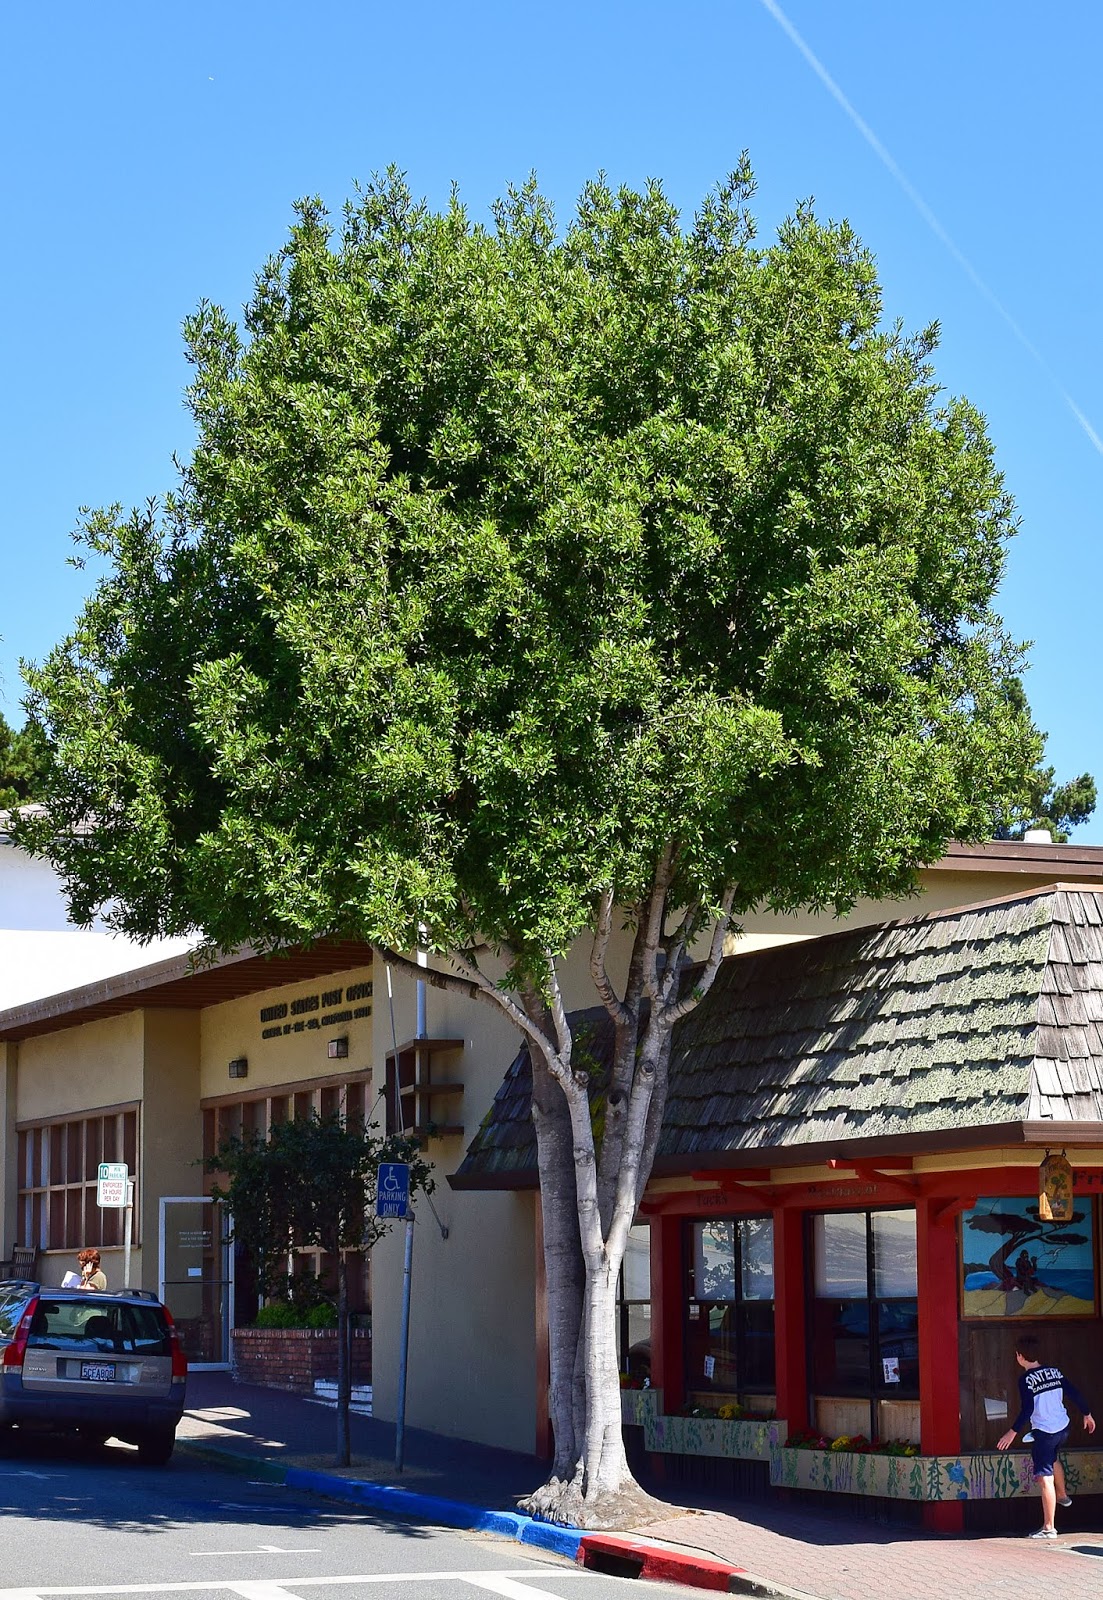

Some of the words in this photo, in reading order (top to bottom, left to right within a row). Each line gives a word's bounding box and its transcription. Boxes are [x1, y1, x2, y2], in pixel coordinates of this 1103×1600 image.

[260, 1003, 288, 1023] UNITED
[290, 995, 320, 1016] STATES
[321, 988, 343, 1008] POST
[100, 1166, 109, 1179] 10
[378, 1191, 406, 1202] PARKING
[383, 1203, 400, 1213] ONLY
